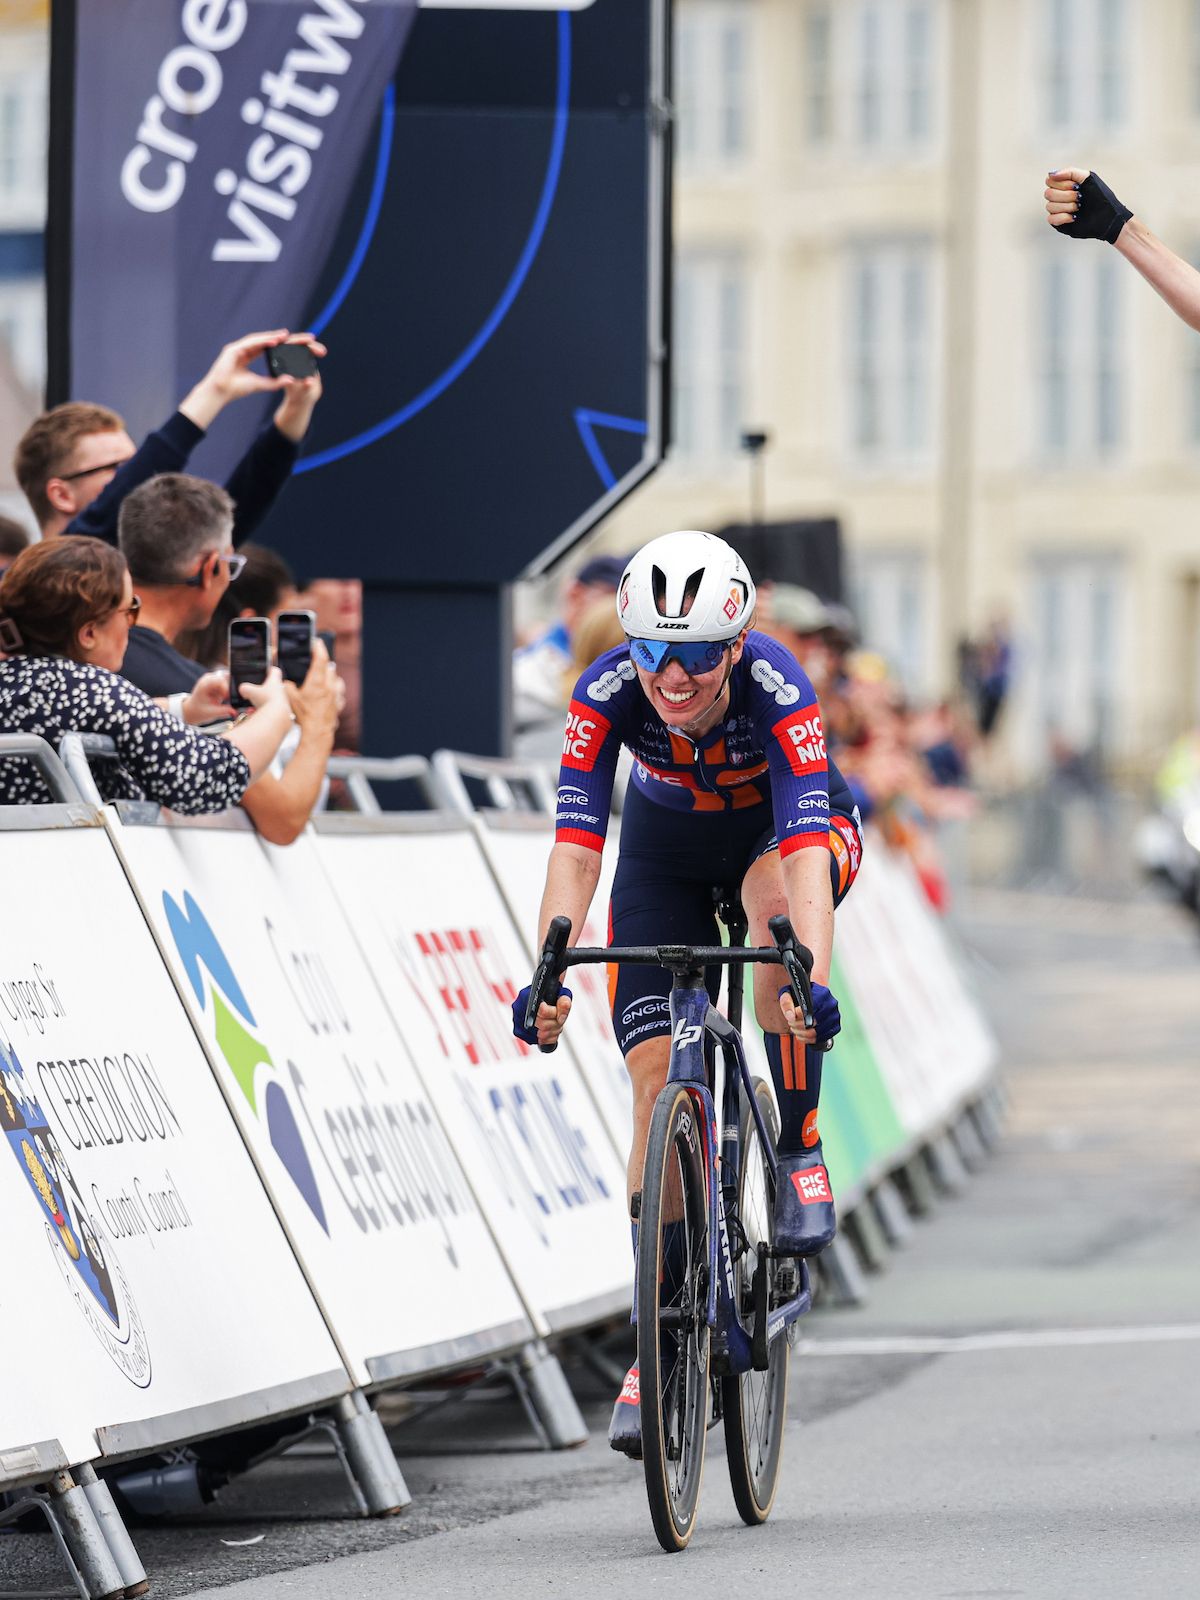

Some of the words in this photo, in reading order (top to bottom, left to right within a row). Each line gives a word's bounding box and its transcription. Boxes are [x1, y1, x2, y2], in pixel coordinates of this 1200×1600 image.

[211, 0, 371, 262] visitw
[656, 622, 690, 631] LAZER
[786, 716, 822, 745] PIC
[786, 815, 830, 829] LAPIE
[621, 1019, 672, 1048] LAPIERR
[37, 1053, 184, 1151] CEREDIGION
[798, 1172, 825, 1189] PIC
[91, 1183, 155, 1250] County
[134, 1168, 193, 1232] Council
